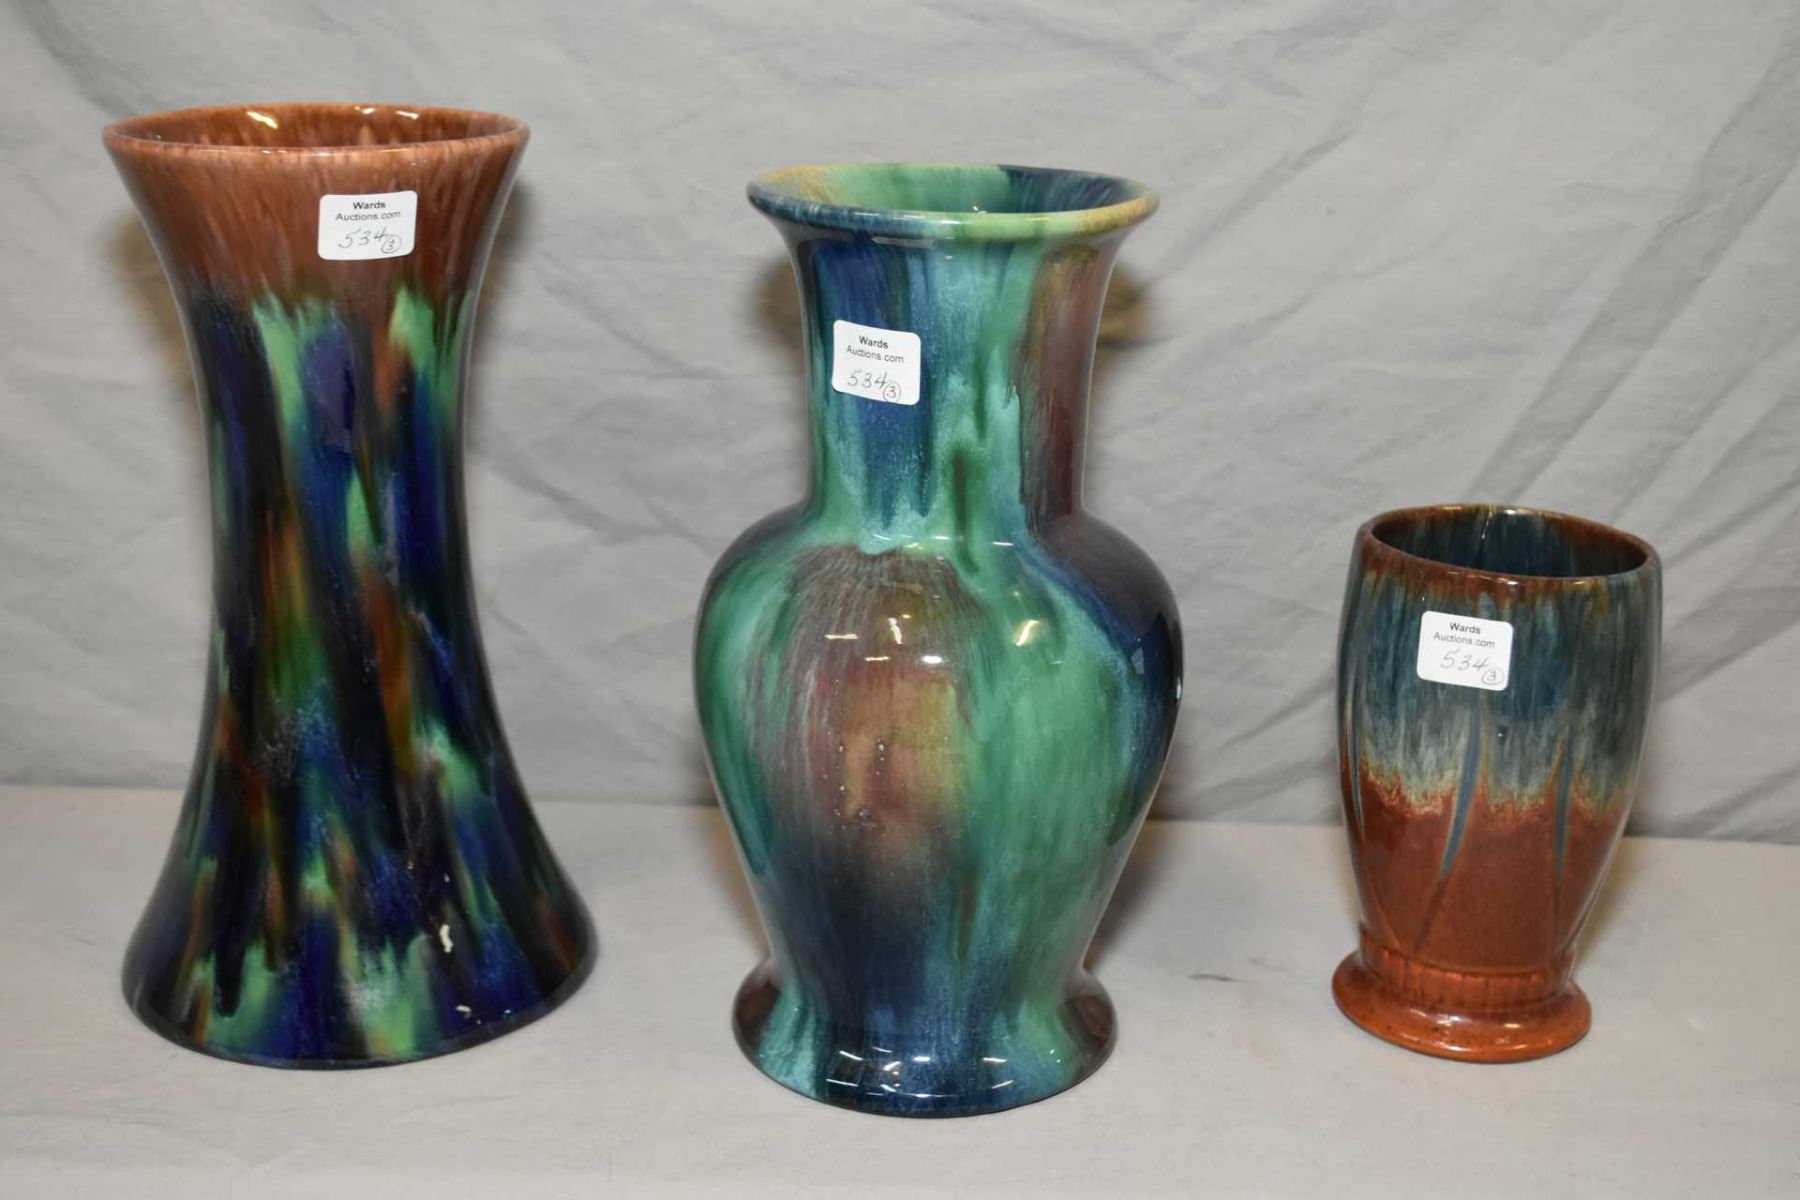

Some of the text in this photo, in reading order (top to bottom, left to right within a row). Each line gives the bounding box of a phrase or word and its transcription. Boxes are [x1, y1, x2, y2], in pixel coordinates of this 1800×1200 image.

[353, 201, 386, 210] Wards
[338, 227, 388, 249] 534
[859, 335, 889, 349] Wards
[847, 369, 887, 389] 534
[1450, 622, 1481, 634] Wards
[1440, 647, 1489, 671] 534
